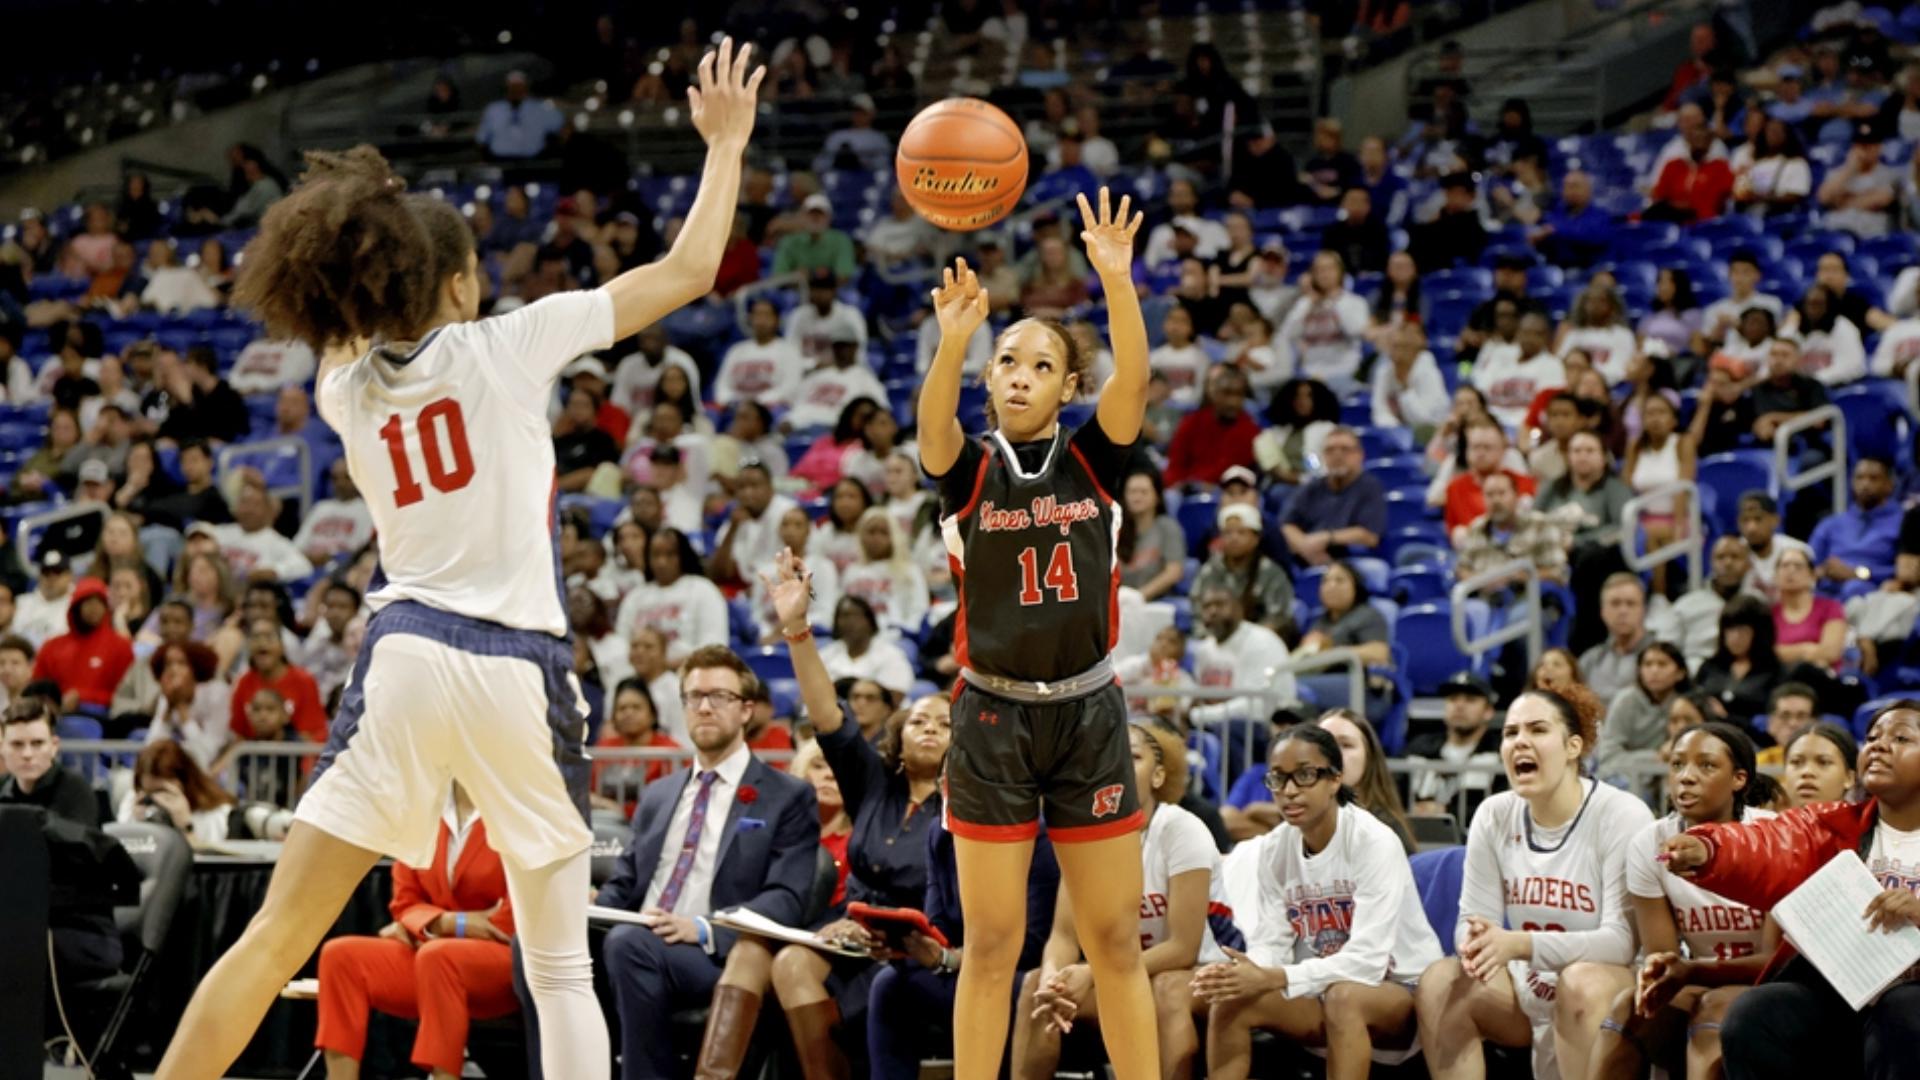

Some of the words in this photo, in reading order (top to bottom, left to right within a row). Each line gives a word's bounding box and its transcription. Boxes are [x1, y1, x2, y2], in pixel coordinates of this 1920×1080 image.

[379, 397, 476, 509] 10
[1032, 494, 1100, 536] Wagner
[1017, 541, 1079, 606] 14
